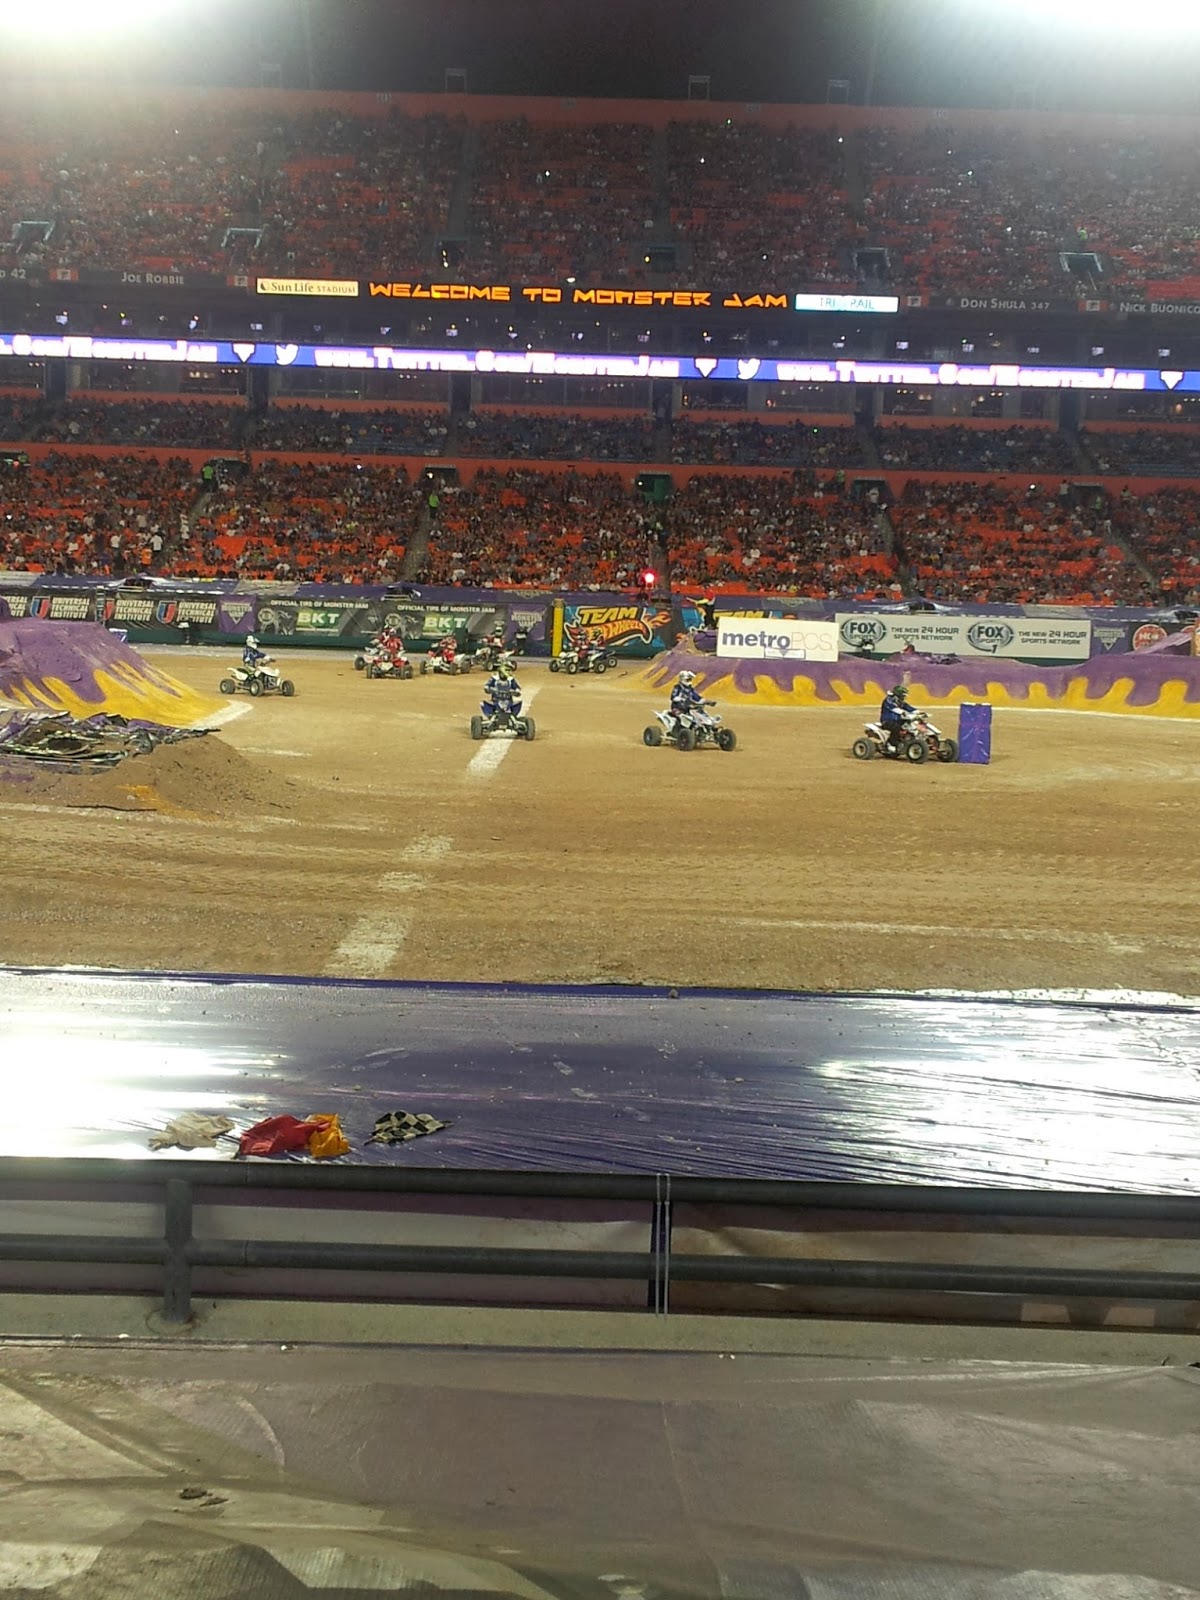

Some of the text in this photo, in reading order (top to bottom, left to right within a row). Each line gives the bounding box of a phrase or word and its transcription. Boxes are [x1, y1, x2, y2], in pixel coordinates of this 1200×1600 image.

[11, 268, 26, 279] 42
[121, 272, 184, 285] JOE ROBBIE
[271, 282, 292, 292] Sun
[294, 282, 314, 293] Life
[369, 282, 788, 308] WELCOME TO MONSTER JAM
[960, 298, 987, 308] DON
[991, 298, 1026, 309] SHULA
[1120, 302, 1146, 313] NICK
[52, 597, 90, 605] UNIVERSAL
[116, 599, 154, 607] UNIVERSAL
[179, 601, 216, 610] UNIVERSAL
[270, 599, 299, 607] OFFICIAL
[51, 604, 88, 612] TECHNICAL
[115, 606, 152, 614] TECHNICAL
[50, 611, 87, 619] INSTITUTE
[114, 613, 151, 621] INSTITUTE
[297, 612, 340, 624] BKT
[579, 606, 639, 625] TEAM
[424, 617, 466, 628] BKT
[849, 622, 877, 634] FOX
[920, 626, 934, 634] 24
[935, 626, 959, 635] HOUR
[977, 625, 1004, 639] FOX
[1048, 629, 1061, 637] 24
[1062, 631, 1087, 639] HOUR
[1021, 637, 1047, 645] SPORTS
[991, 644, 998, 654] 1
